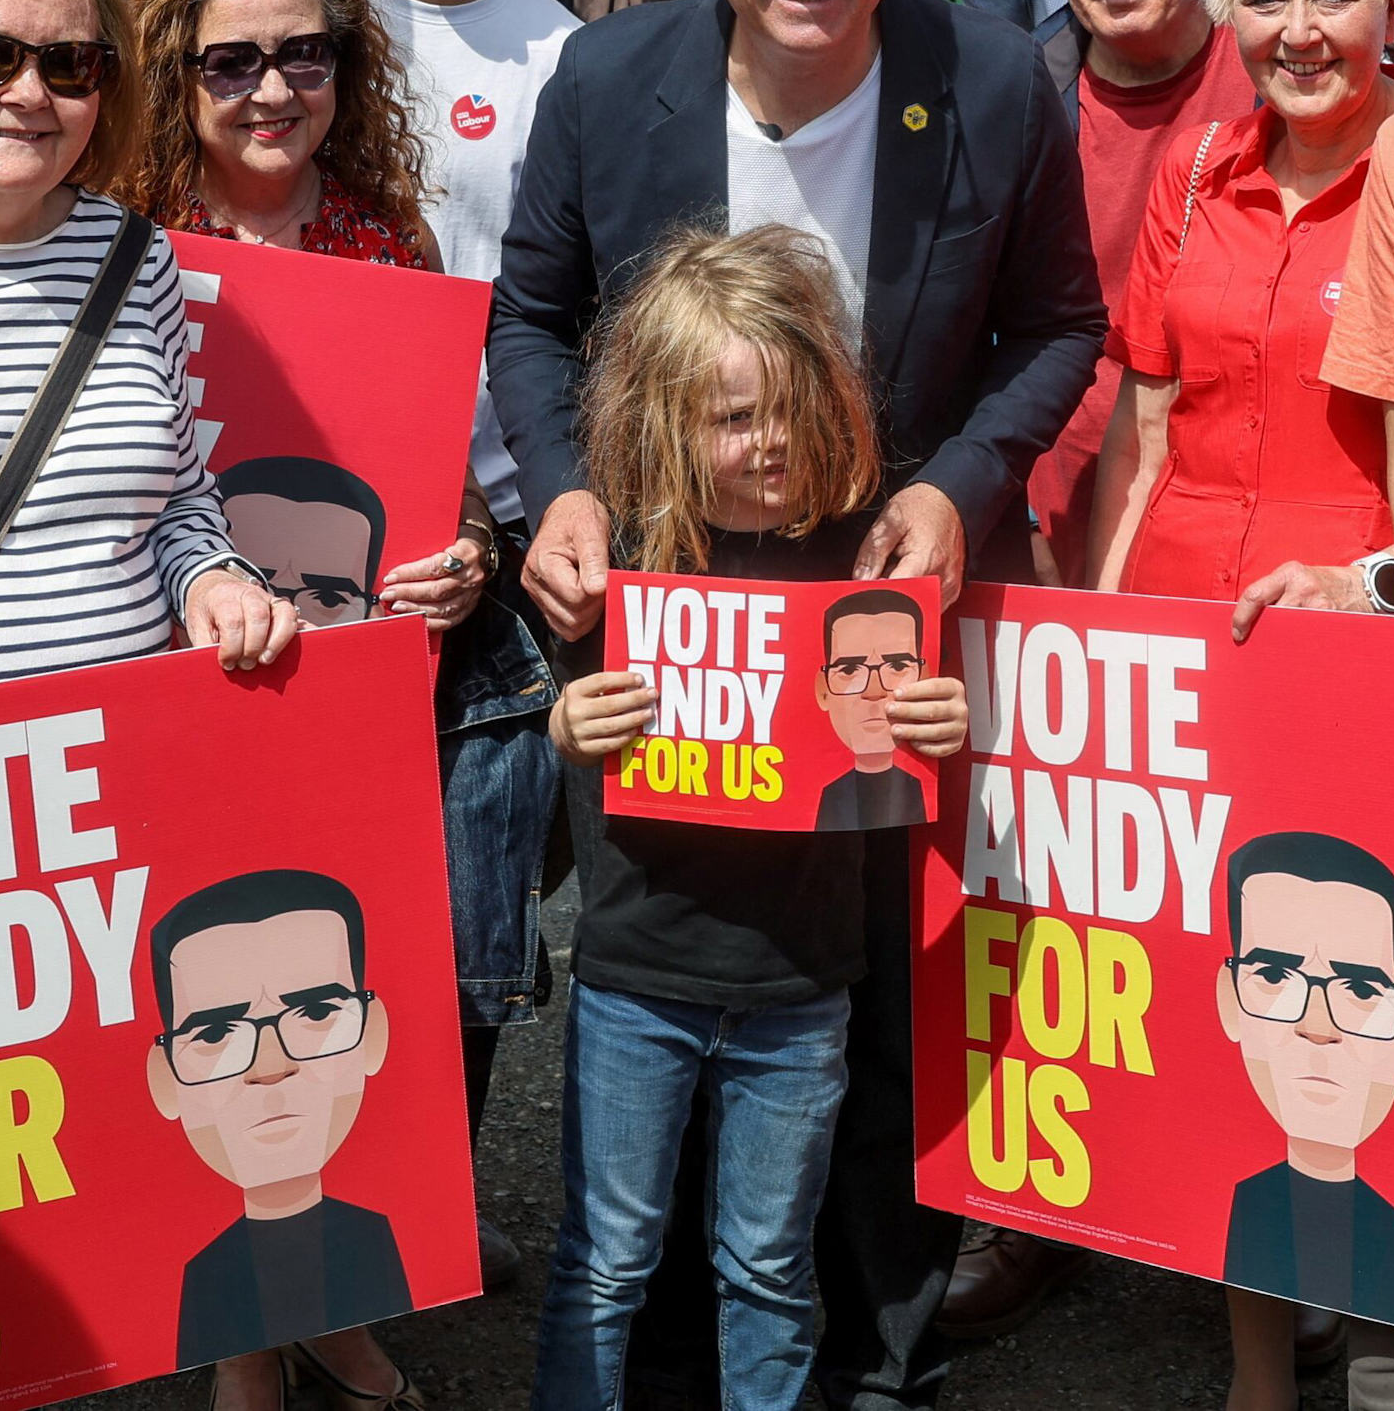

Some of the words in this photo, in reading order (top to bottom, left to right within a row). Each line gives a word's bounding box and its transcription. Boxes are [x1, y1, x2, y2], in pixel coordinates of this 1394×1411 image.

[457, 115, 491, 128] Labour
[622, 585, 786, 672] VOTE
[958, 617, 1208, 781] VOTE
[620, 737, 709, 796] FOR
[721, 743, 784, 802] US
[961, 764, 1231, 935] ANDY
[963, 907, 1155, 1077] FOR
[966, 1050, 1091, 1209] US
